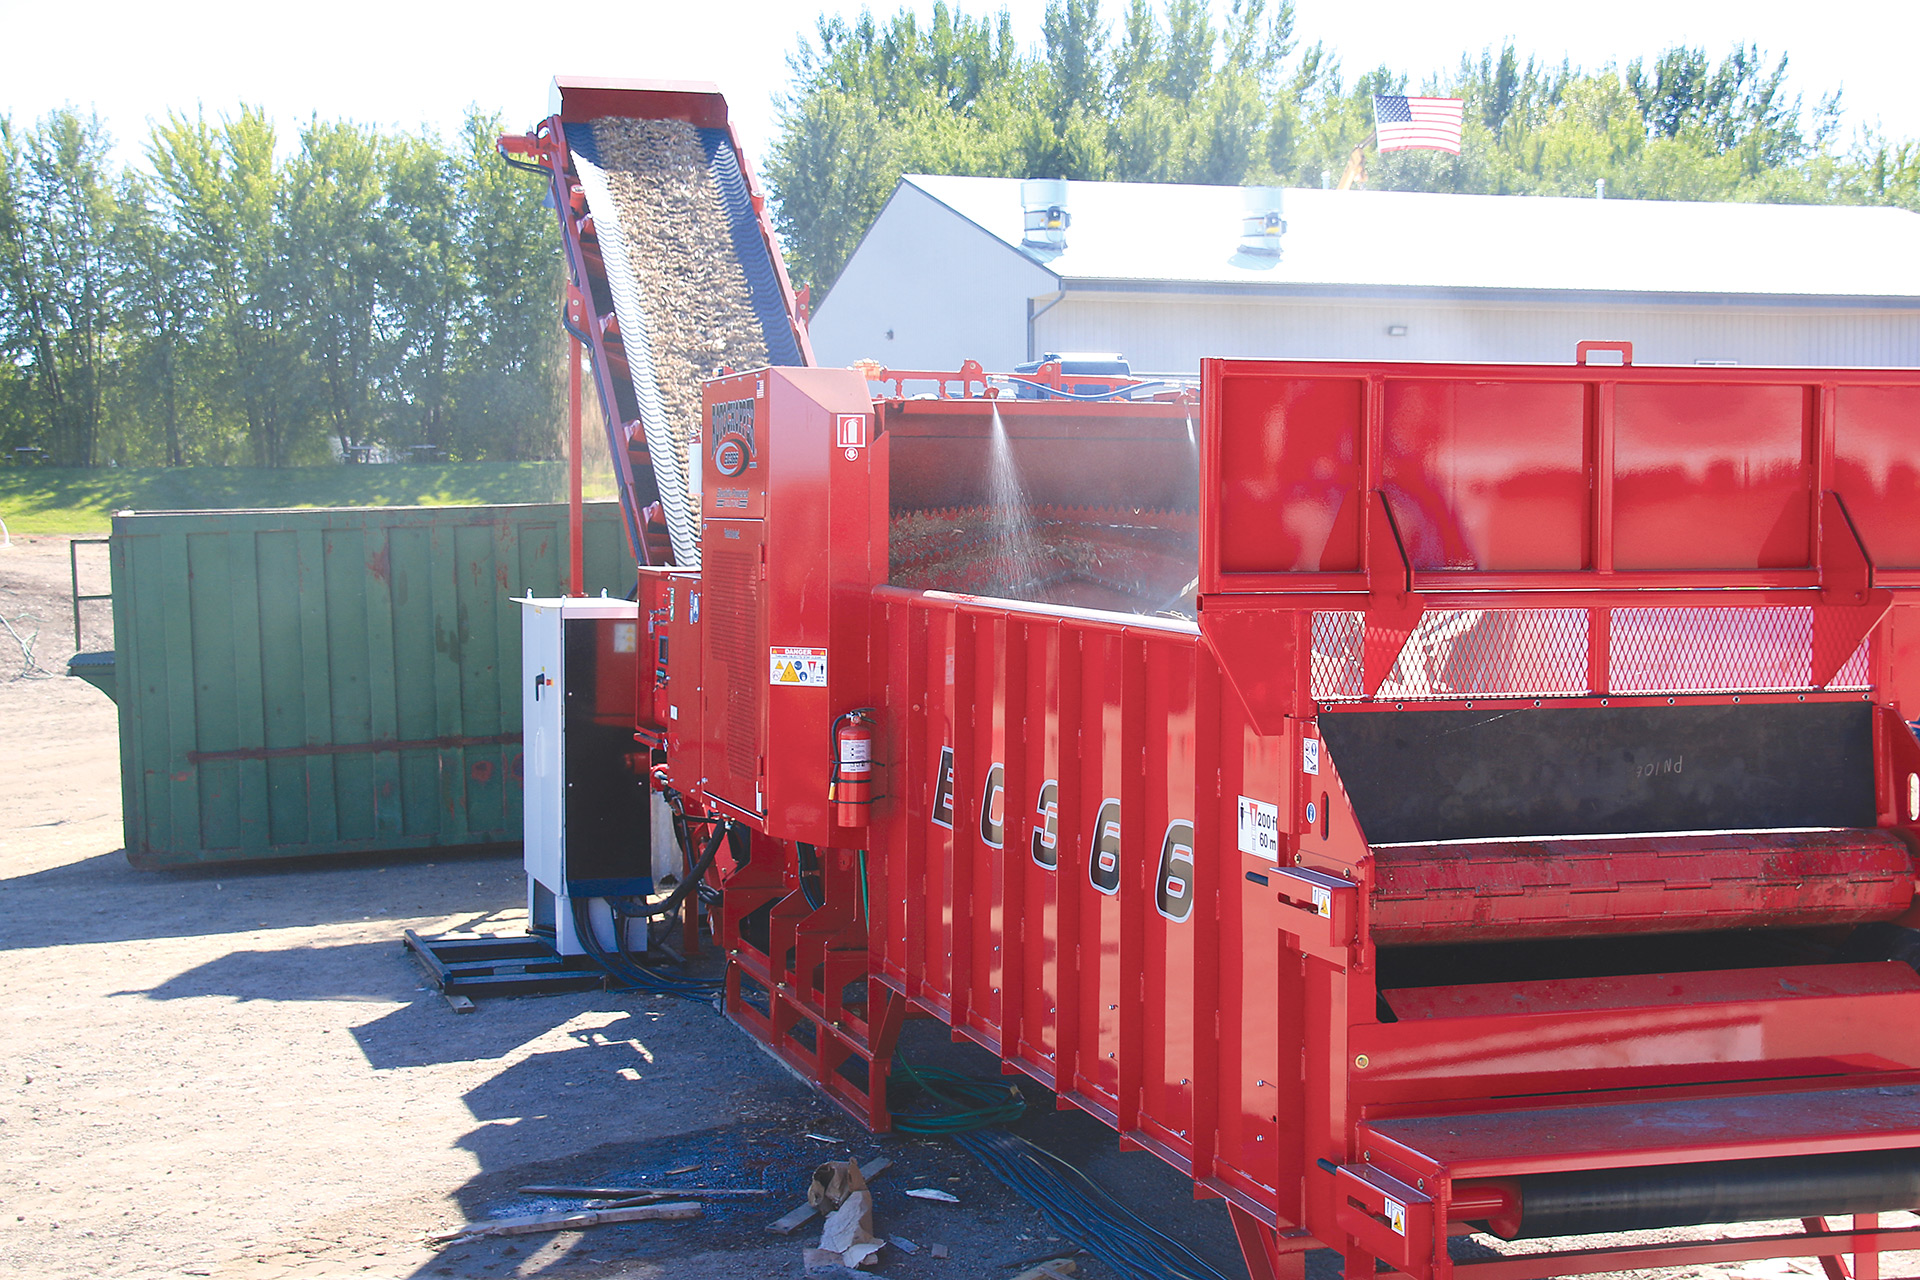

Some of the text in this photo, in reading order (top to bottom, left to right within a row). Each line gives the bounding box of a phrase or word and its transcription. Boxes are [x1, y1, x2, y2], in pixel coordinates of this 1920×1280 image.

[1257, 812, 1271, 829] 200
[1259, 832, 1276, 851] 60 m
